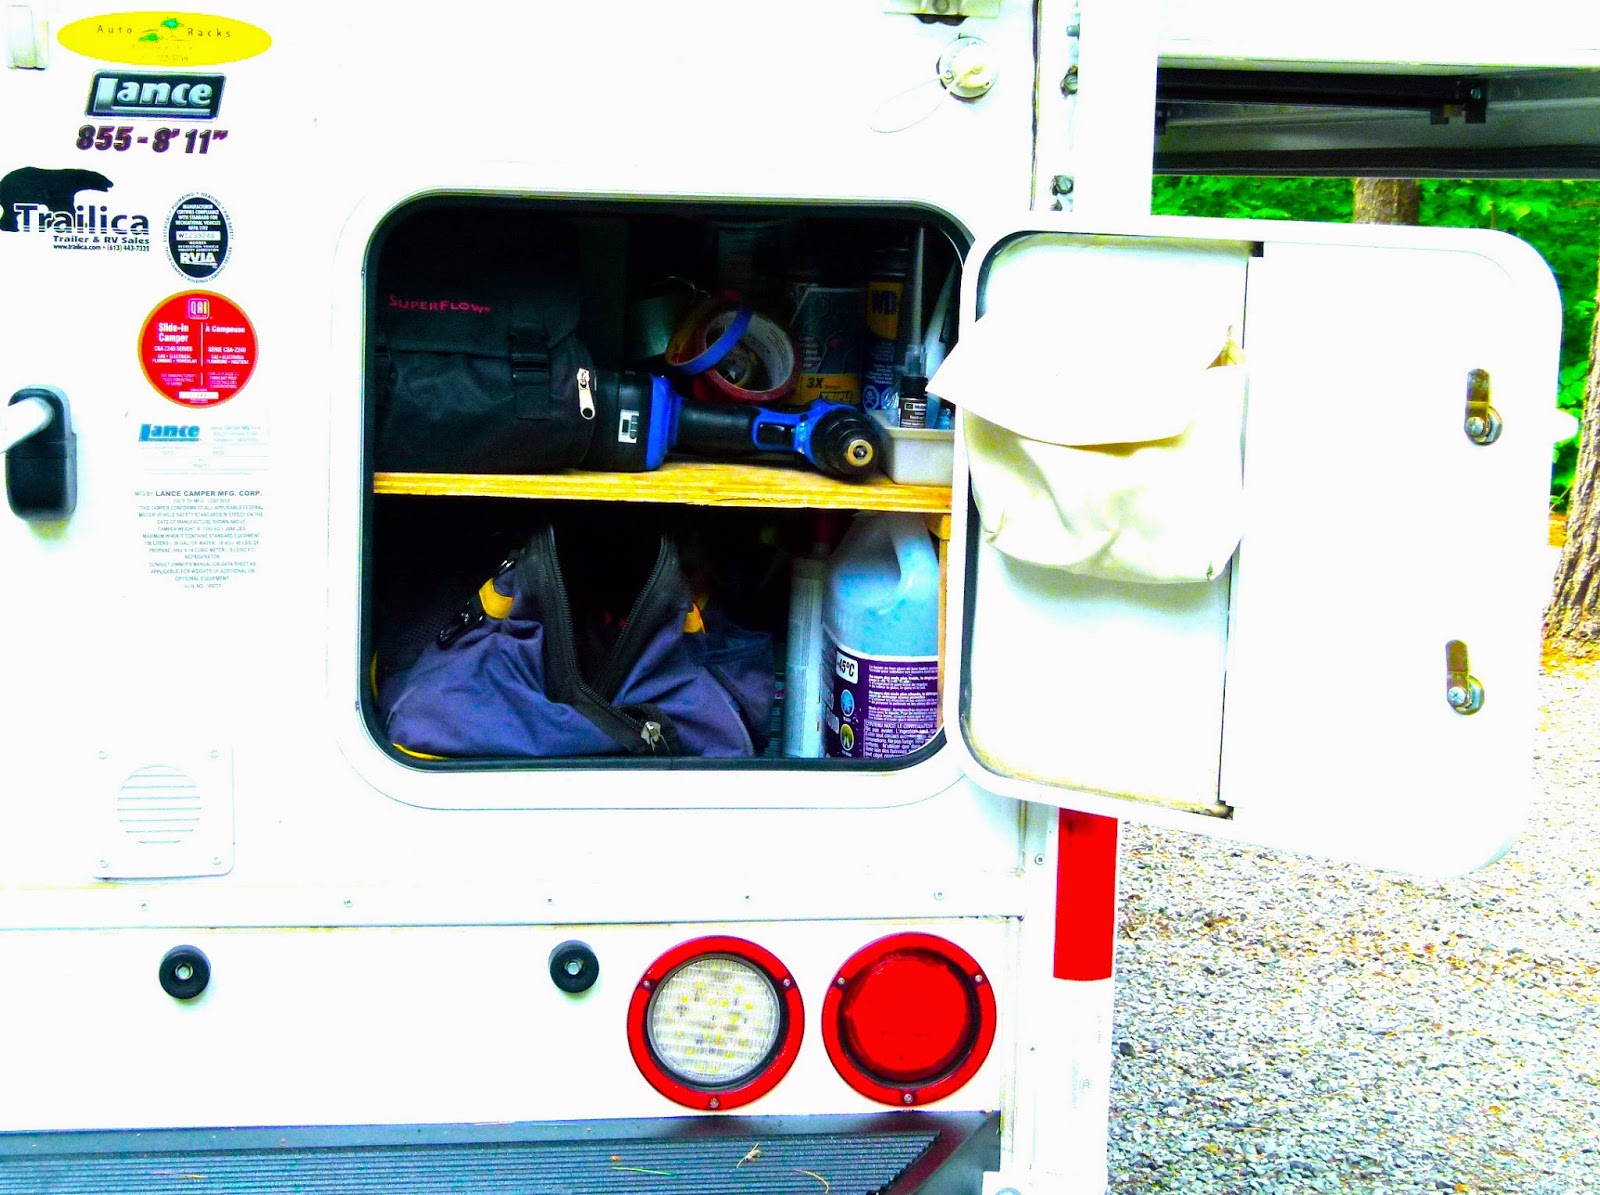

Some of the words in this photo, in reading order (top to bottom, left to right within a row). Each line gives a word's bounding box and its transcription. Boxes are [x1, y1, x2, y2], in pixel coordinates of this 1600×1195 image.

[96, 24, 132, 34] Auto
[187, 27, 231, 37] Racks
[92, 77, 214, 113] Lance
[76, 124, 134, 152] 855
[15, 204, 149, 235] Trailica
[53, 235, 89, 243] Trailer
[53, 243, 101, 251] www.trailica.com
[107, 244, 122, 252] (613)
[180, 252, 217, 264] RVIA
[190, 301, 207, 315] QAI
[211, 325, 245, 334] Campeuse
[158, 332, 189, 344] Camper
[806, 377, 824, 389] 3X
[138, 423, 201, 442] Lance
